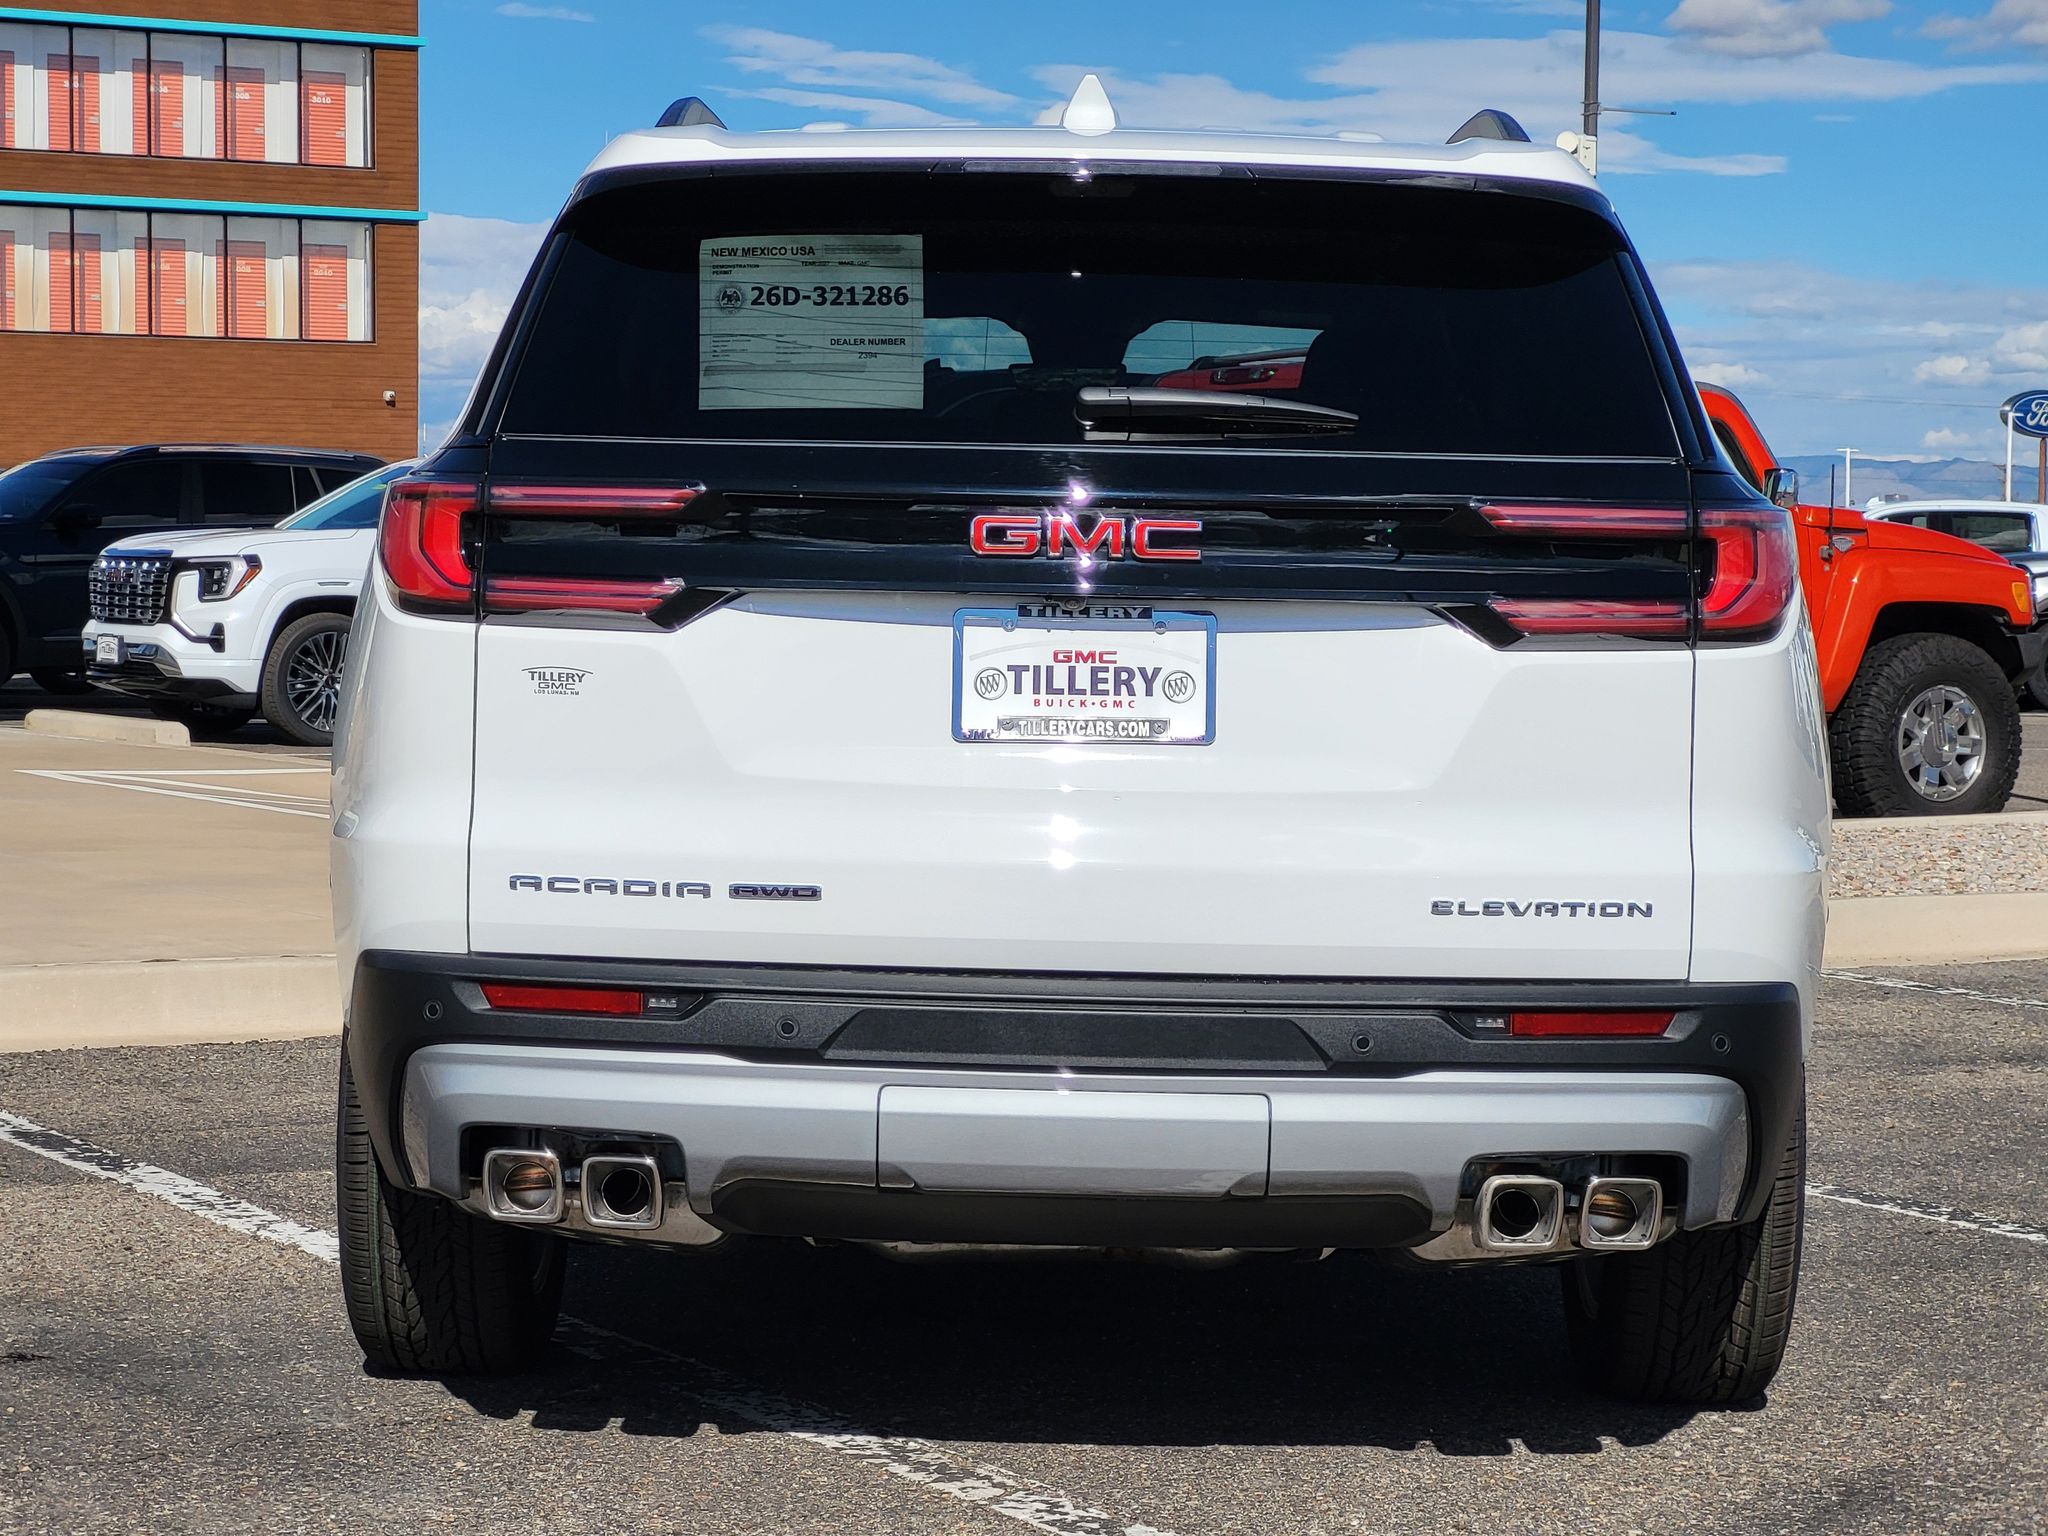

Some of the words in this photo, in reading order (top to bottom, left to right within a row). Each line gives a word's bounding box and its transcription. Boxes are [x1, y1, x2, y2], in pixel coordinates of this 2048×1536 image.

[711, 247, 738, 257] NEW
[741, 246, 787, 257] MEXICO
[790, 246, 816, 256] USA
[750, 286, 909, 306] 26D-321286
[830, 338, 866, 346] DEALER
[868, 338, 906, 346] NUMBER
[970, 515, 1202, 560] GMC
[1026, 605, 1146, 618] TILLERY
[1053, 650, 1118, 665] GMC
[528, 671, 586, 683] TILLERY
[1007, 664, 1163, 697] TILLERY
[538, 682, 576, 690] GMC
[1018, 720, 1150, 738] TILLERYCARS.COM
[509, 875, 711, 899] ACADIA
[733, 886, 818, 897] AWD
[1431, 900, 1653, 918] ELEVATION
